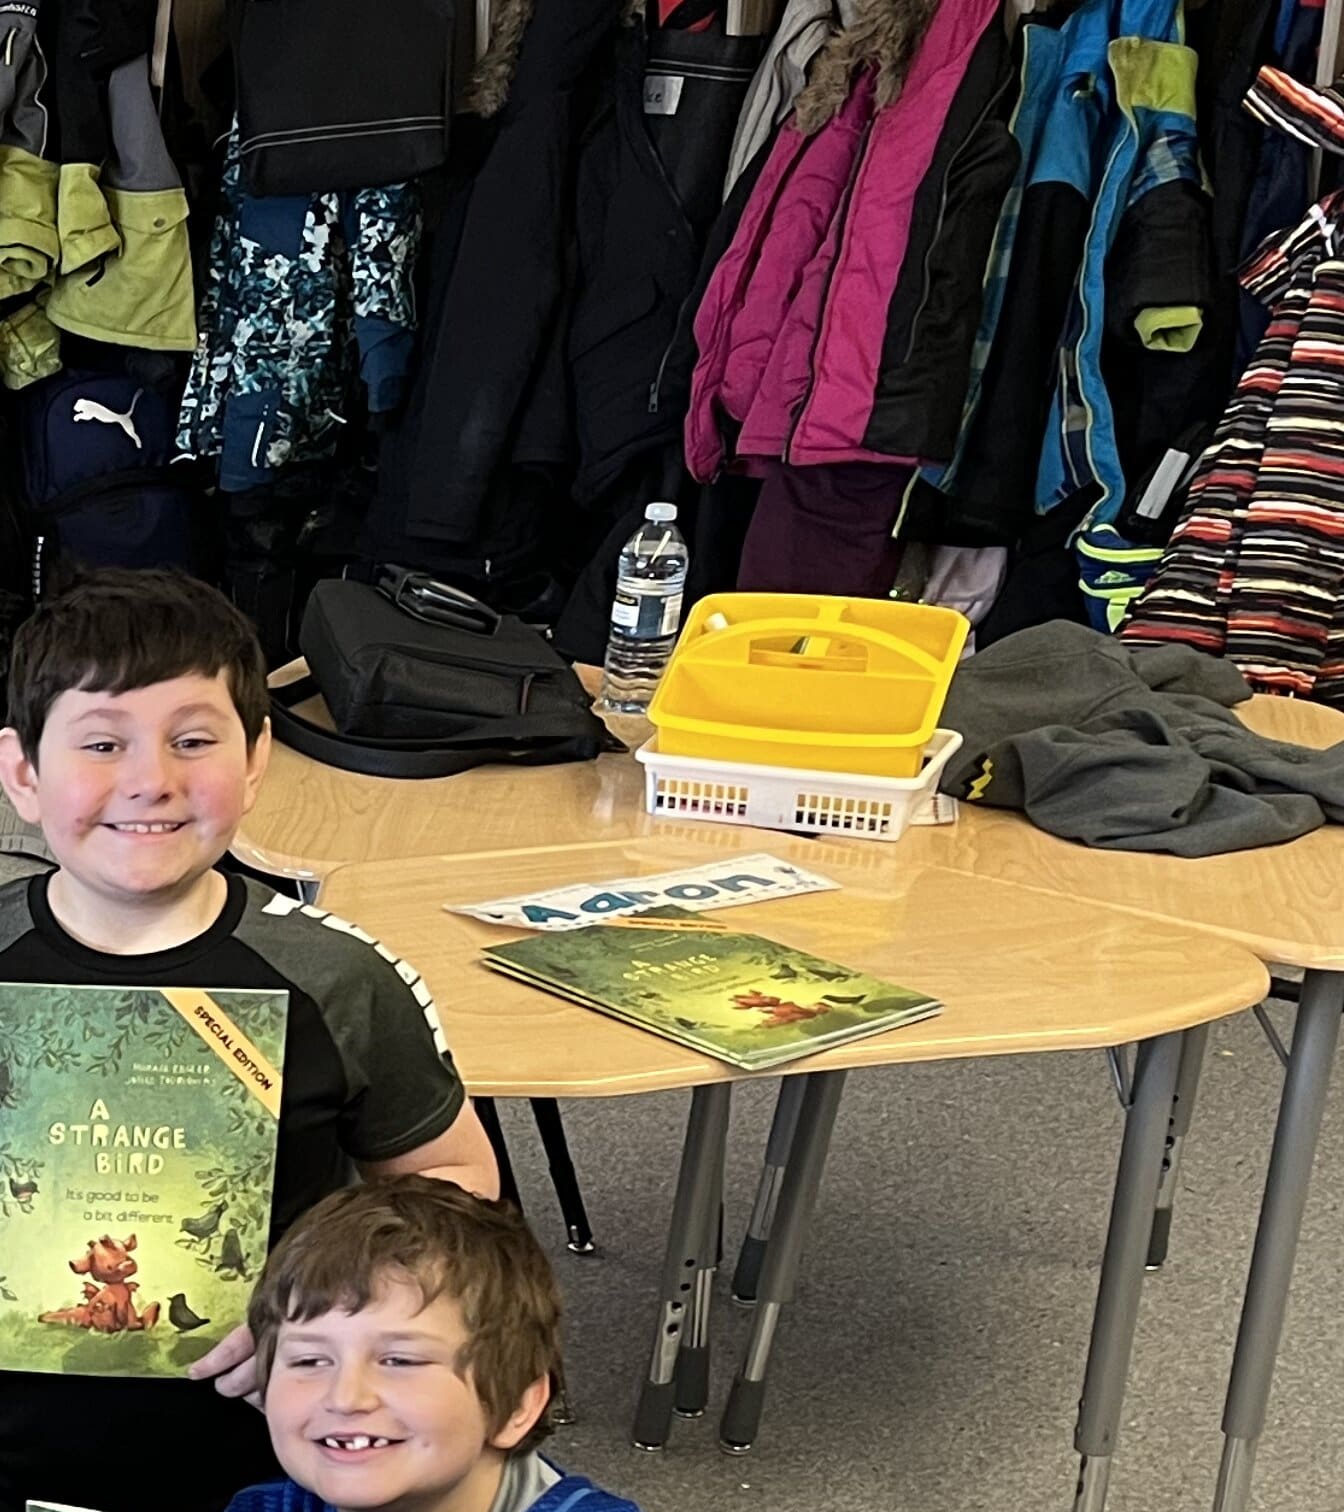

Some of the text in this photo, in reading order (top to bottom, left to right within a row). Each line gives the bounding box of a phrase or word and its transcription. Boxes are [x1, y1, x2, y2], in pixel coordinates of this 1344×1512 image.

[520, 873, 776, 923] Aaron
[194, 1005, 273, 1091] SPECIAL EDITION
[89, 1098, 110, 1121] A
[47, 1122, 187, 1150] STRANGE
[86, 1190, 121, 1204] good
[125, 1191, 139, 1202] to
[141, 1191, 160, 1203] be
[83, 1210, 174, 1224] a bit different
